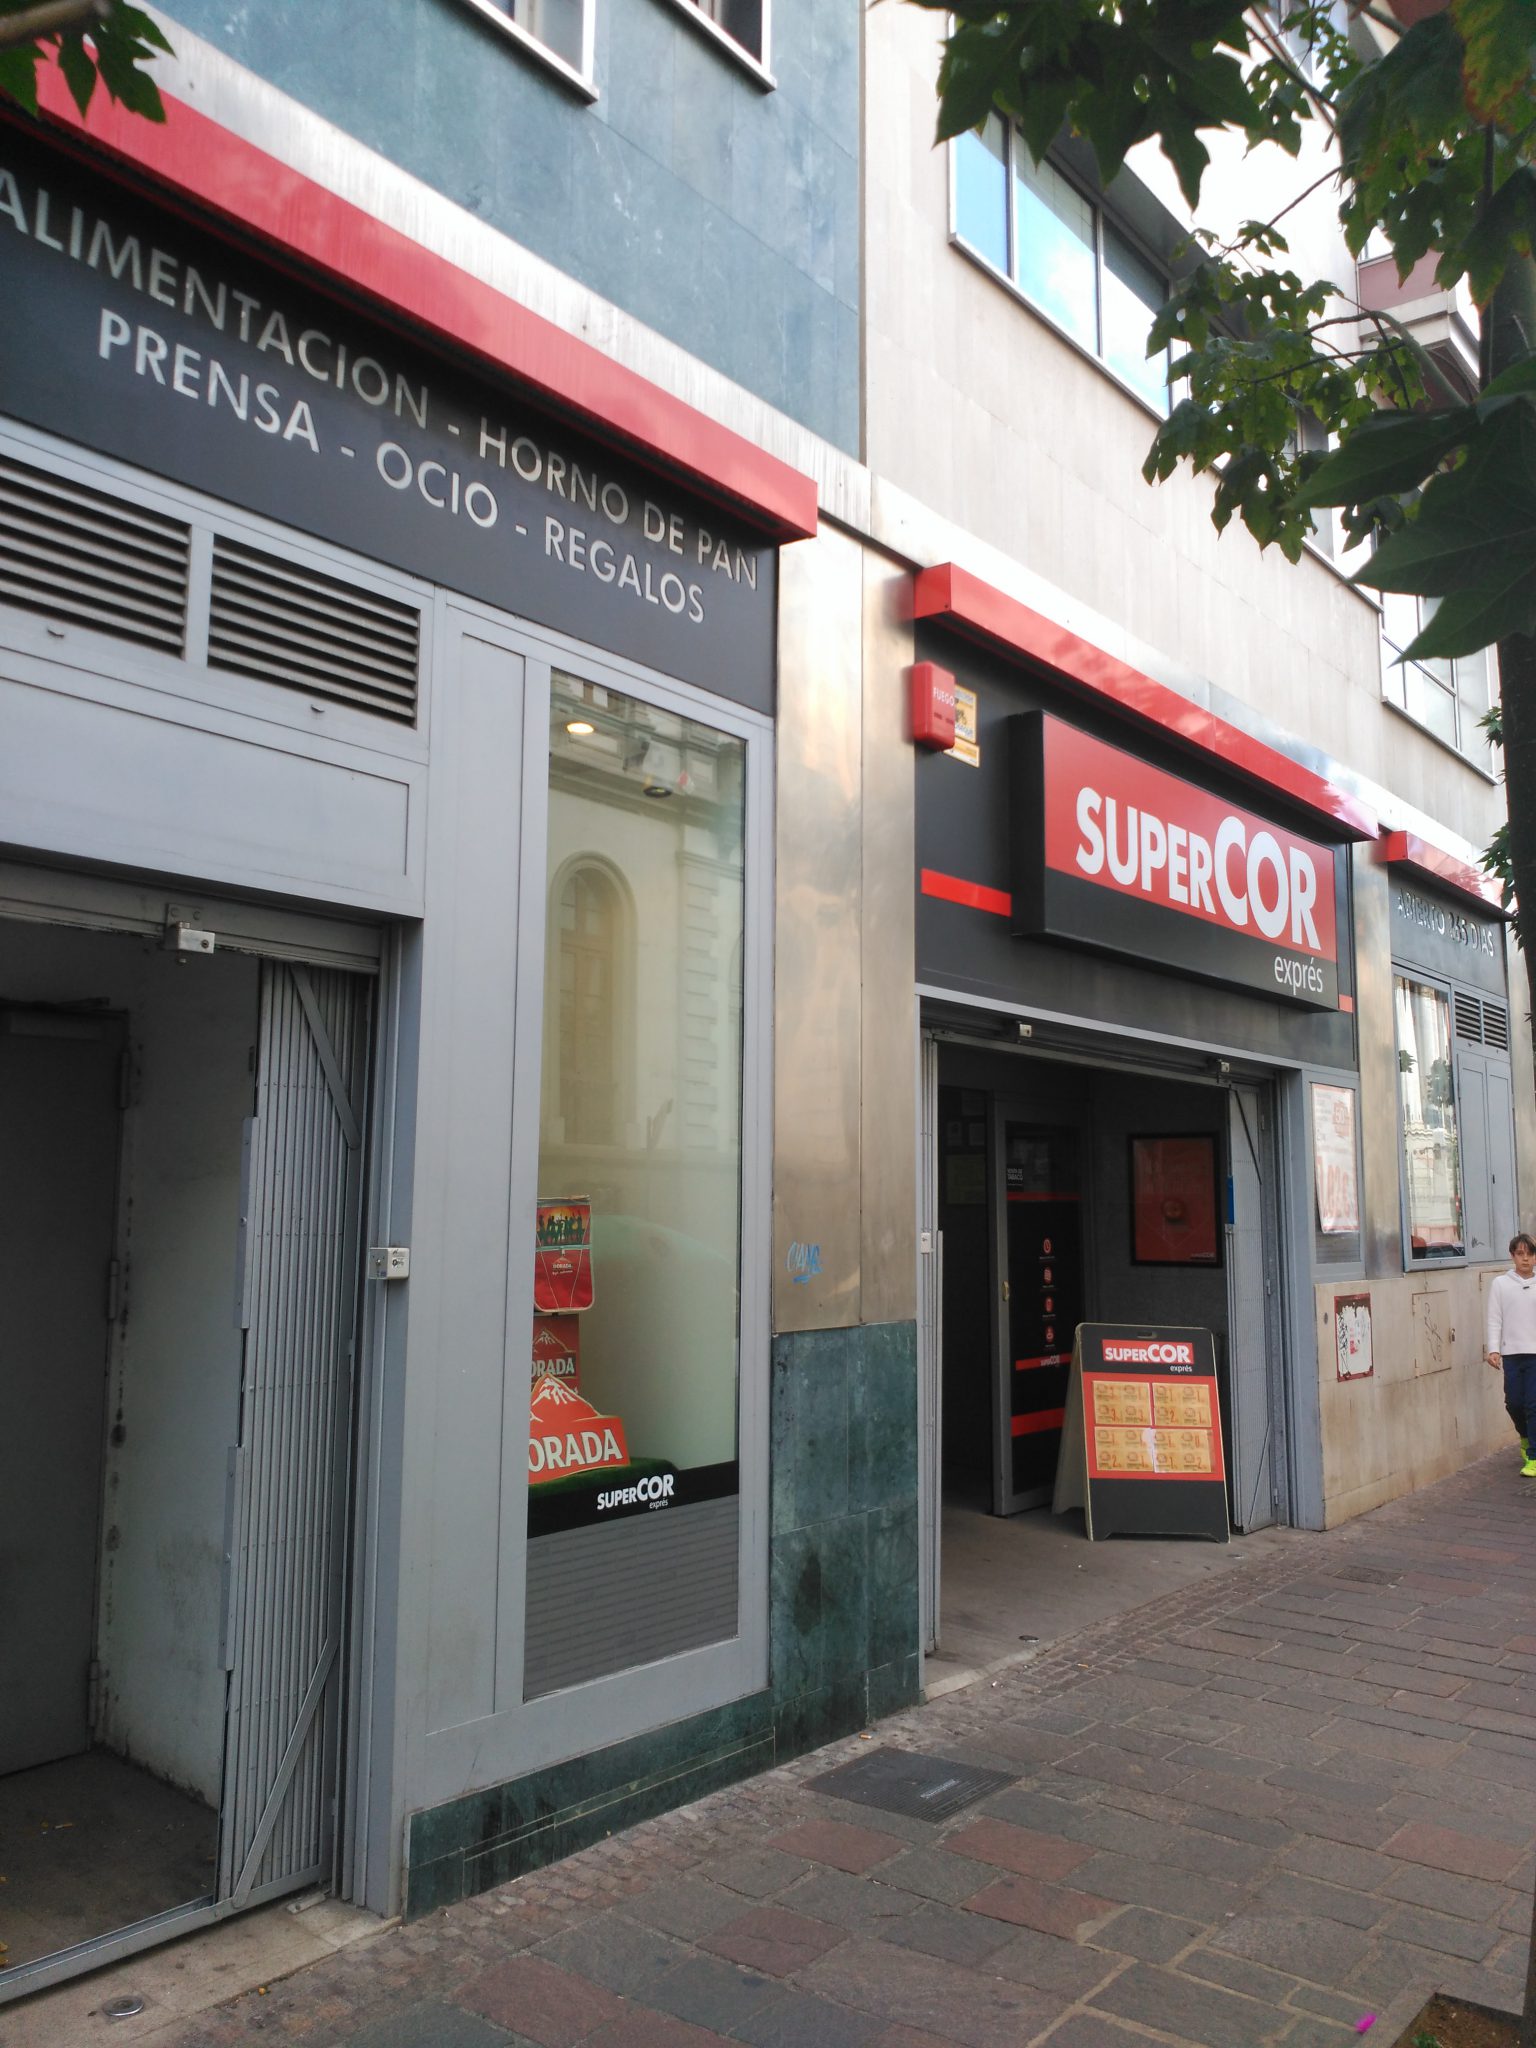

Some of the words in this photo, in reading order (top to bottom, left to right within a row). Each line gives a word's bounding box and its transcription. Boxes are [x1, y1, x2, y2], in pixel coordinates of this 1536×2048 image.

[0, 168, 428, 430] ALIMENTACION
[479, 416, 629, 525] HORNO
[643, 500, 684, 555] DE
[698, 527, 758, 590] PAN
[99, 307, 320, 453] PRENSA
[376, 441, 499, 528] OCIO
[545, 515, 705, 624] REGALOS
[933, 687, 955, 707] FUEGO
[1075, 786, 1322, 951] SUPERCOR
[1274, 955, 1324, 996] exprés
[1105, 1343, 1191, 1364] SUPERCOR
[1169, 1365, 1192, 1374] exprés
[597, 1473, 674, 1510] SUPERCOR
[649, 1498, 669, 1510] exprés
